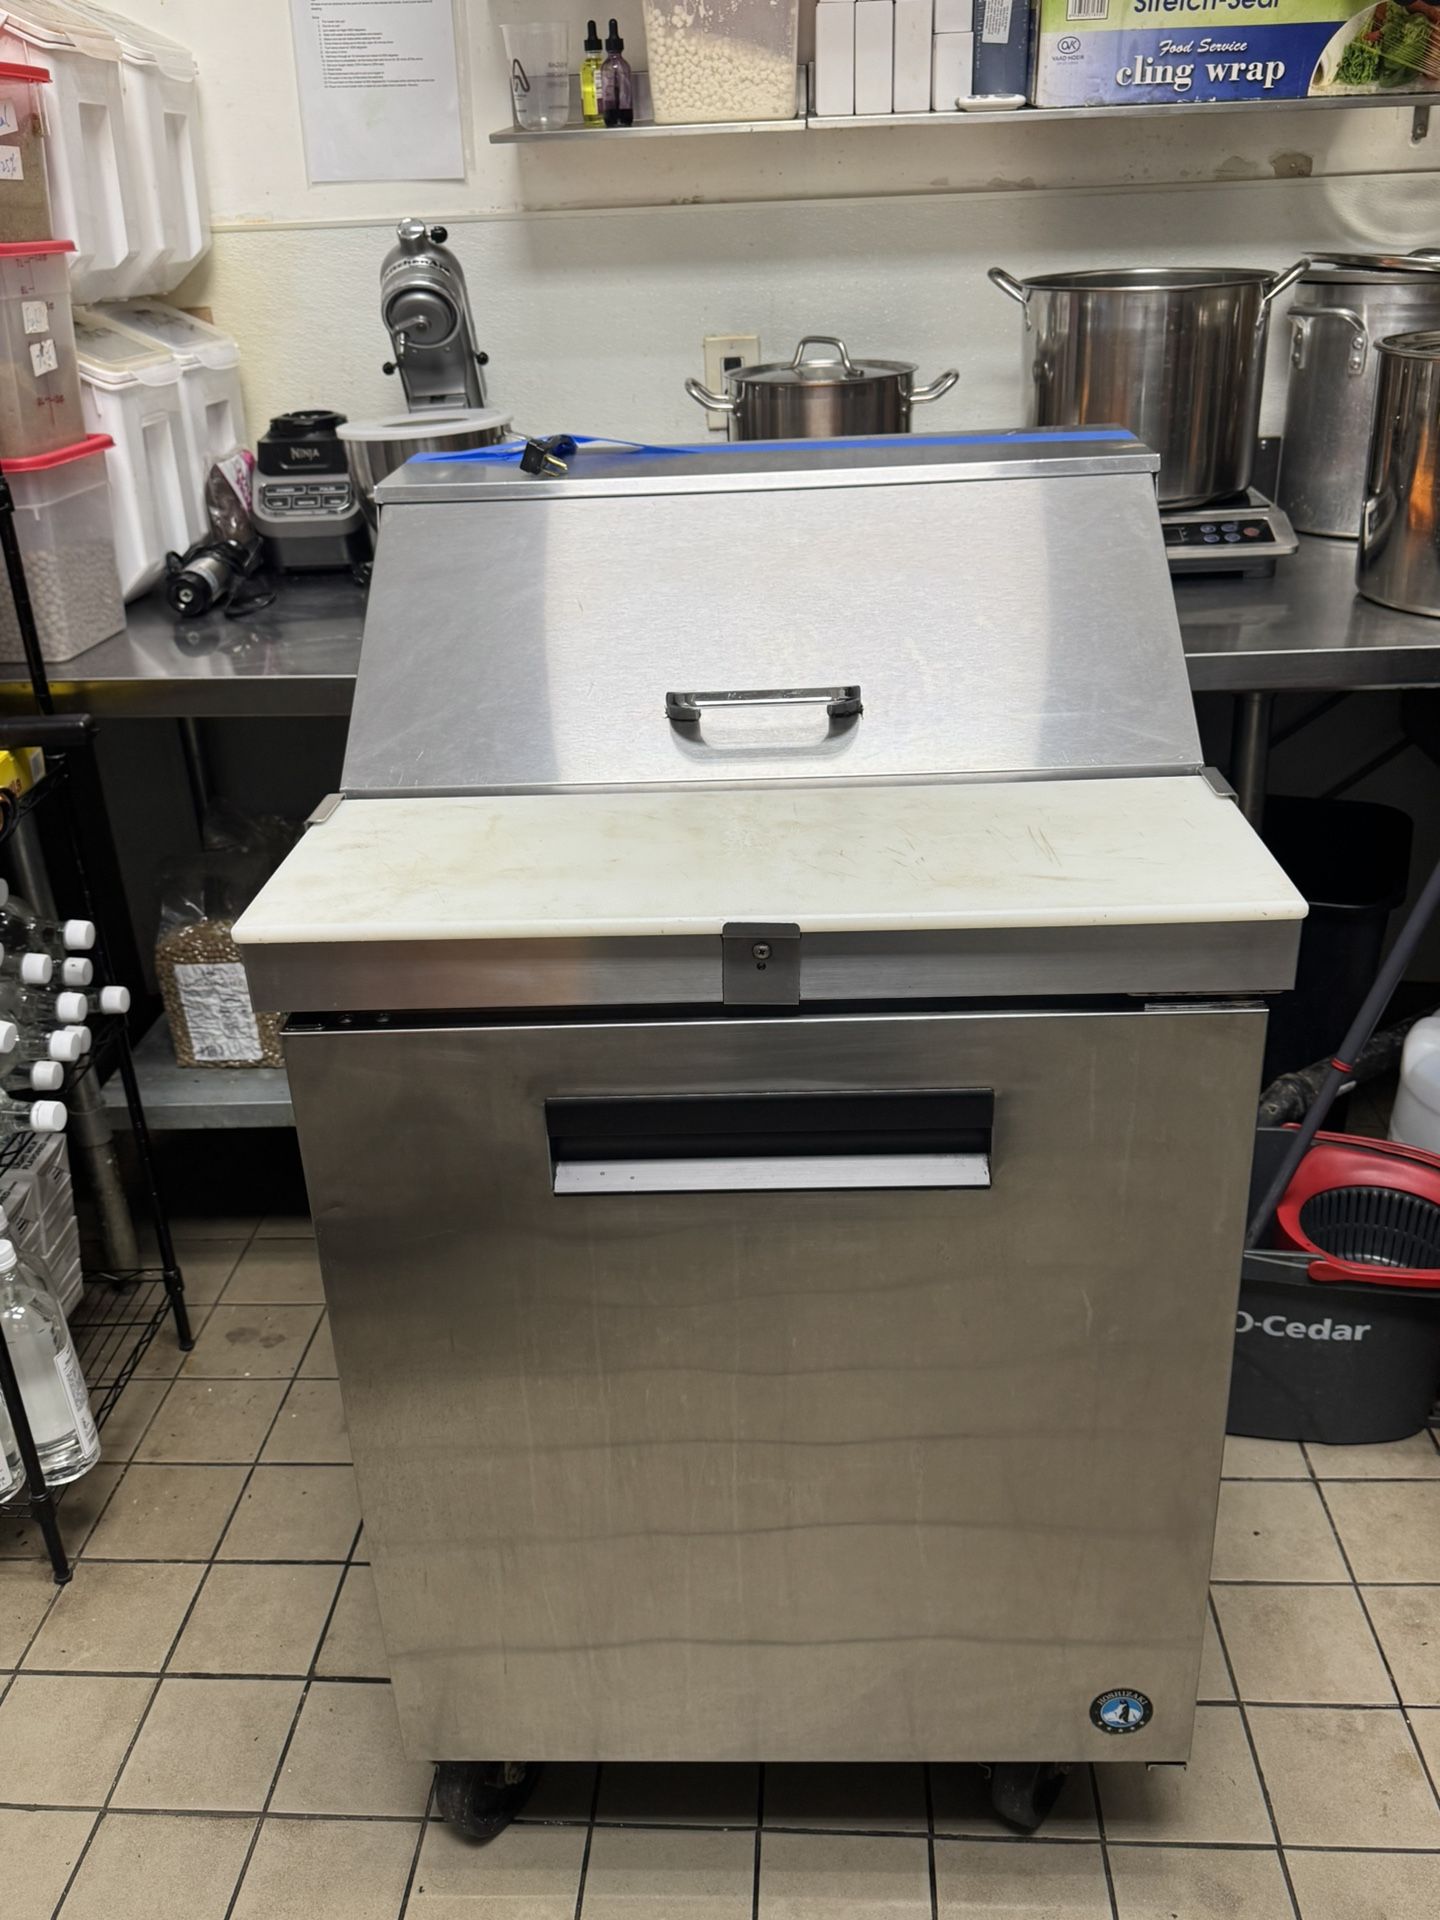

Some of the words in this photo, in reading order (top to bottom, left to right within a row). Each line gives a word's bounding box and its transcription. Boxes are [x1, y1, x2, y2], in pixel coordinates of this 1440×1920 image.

[1134, 0, 1280, 13] Stretch-Seal
[1159, 39, 1194, 56] Food
[1197, 38, 1248, 54] Service
[1116, 55, 1195, 92] cling
[1205, 60, 1286, 89] wrap
[290, 447, 320, 461] NINJA
[1096, 1690, 1149, 1706] HOSHIZAKI
